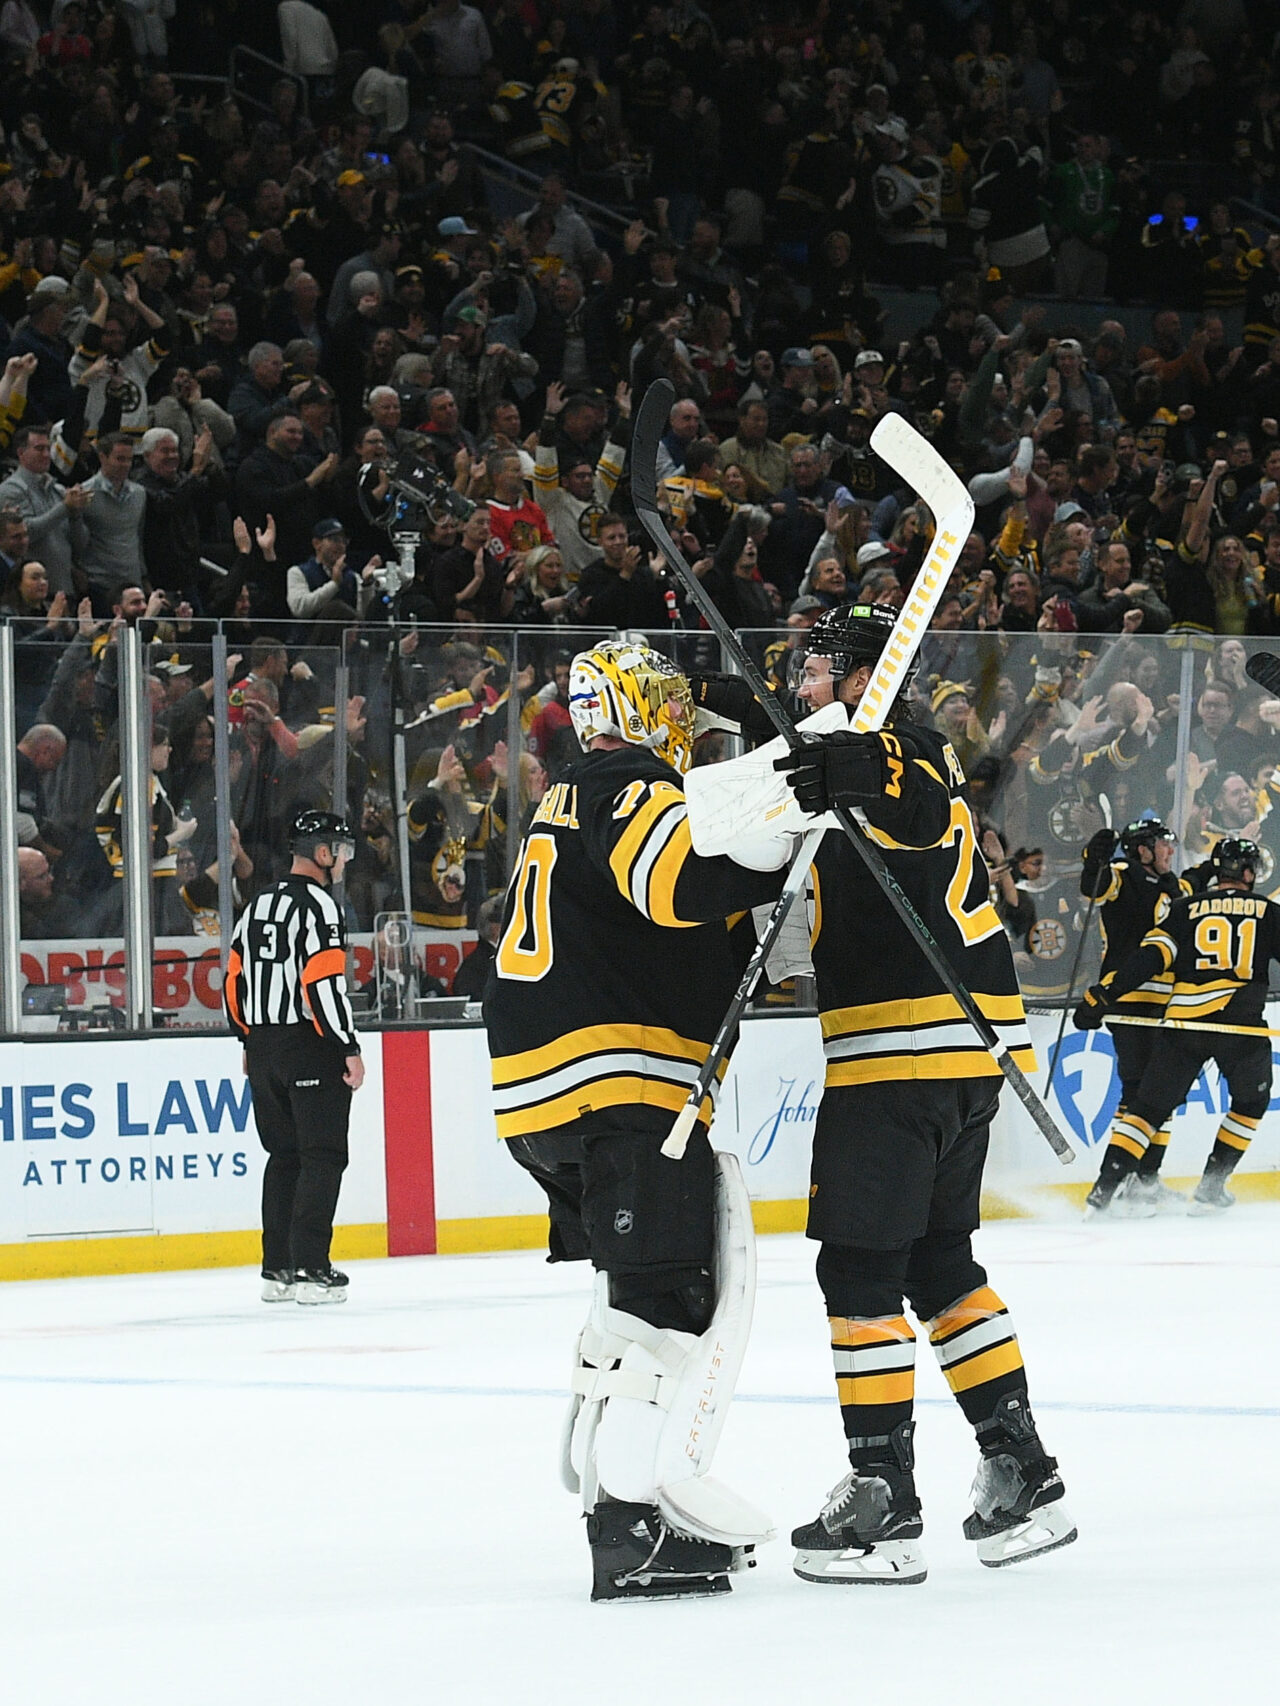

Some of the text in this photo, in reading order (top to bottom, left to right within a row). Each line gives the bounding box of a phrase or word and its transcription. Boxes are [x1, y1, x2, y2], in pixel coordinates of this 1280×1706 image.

[873, 609, 896, 620] Bank
[496, 833, 559, 982] 0
[1188, 897, 1268, 920] ZADOROV
[259, 923, 278, 960] 3
[330, 924, 339, 938] 3
[1195, 915, 1257, 980] 91
[117, 1078, 254, 1138] LAW
[22, 1151, 249, 1187] ATTORNEYS
